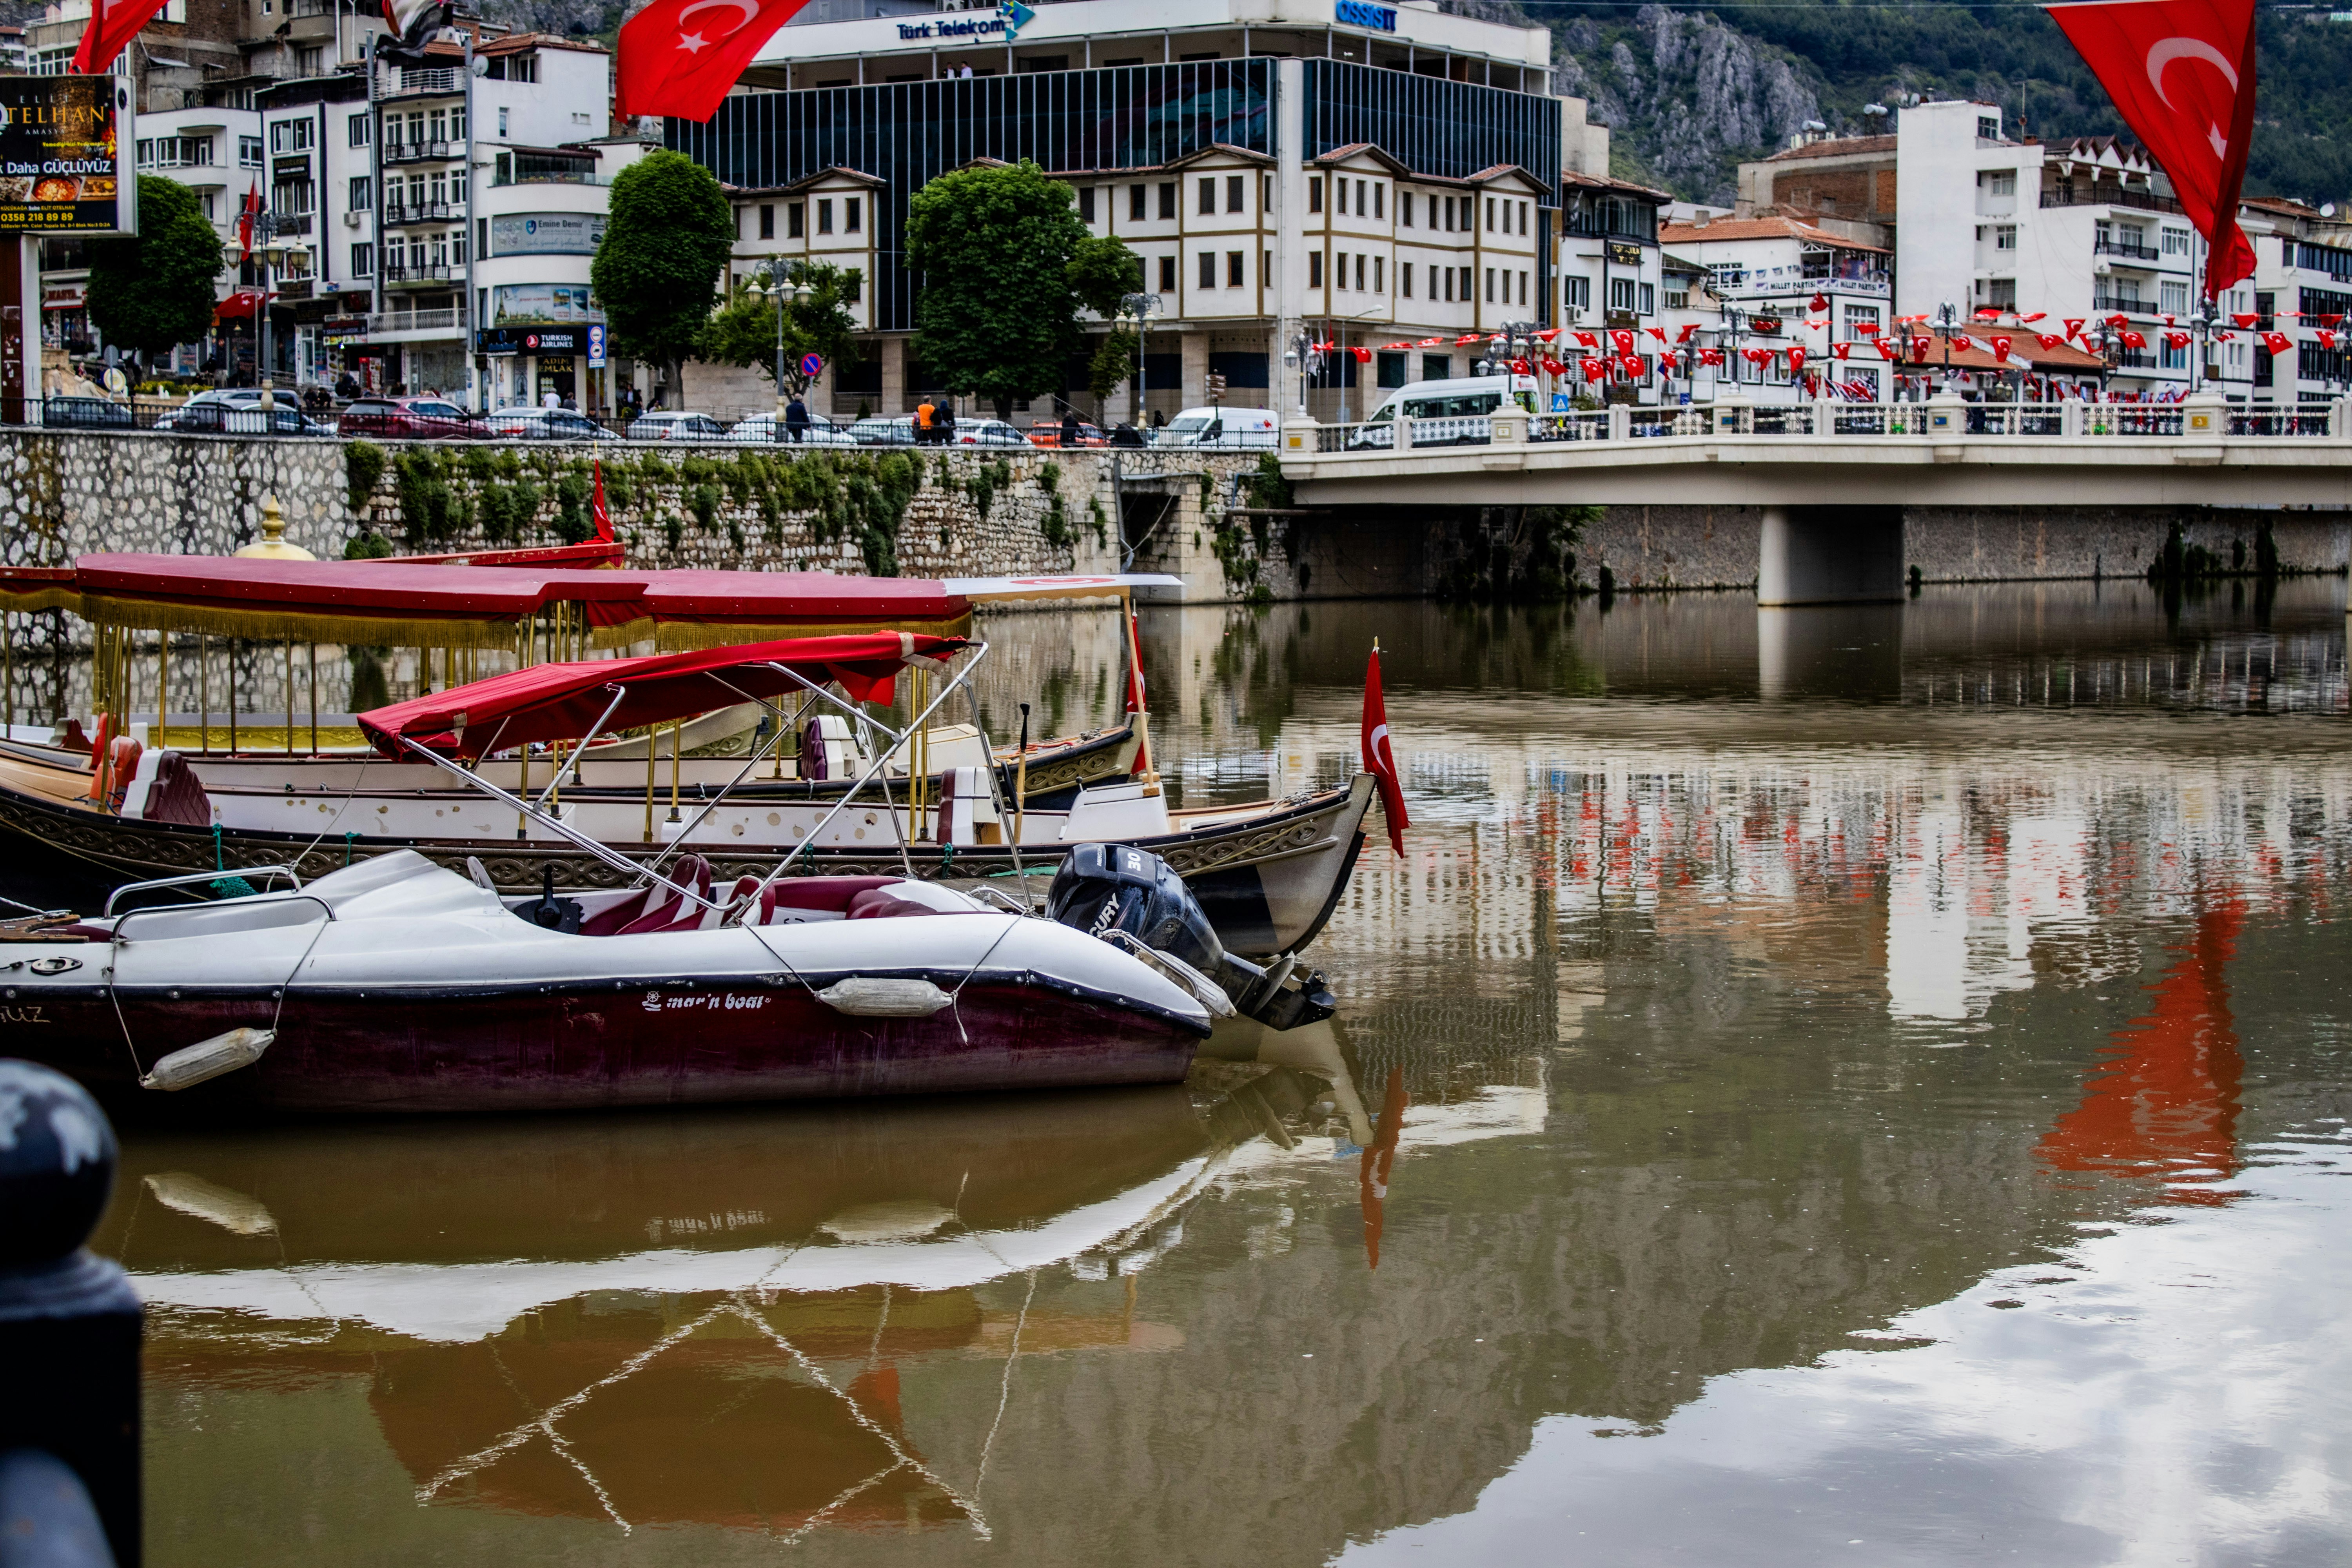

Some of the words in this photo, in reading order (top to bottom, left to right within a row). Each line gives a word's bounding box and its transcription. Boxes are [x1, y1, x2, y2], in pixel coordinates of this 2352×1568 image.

[897, 22, 930, 39] Türk
[935, 18, 1005, 36] Telekom
[7, 162, 39, 174] Daha
[43, 158, 111, 176] GÜÇLÜYÜZ
[1, 213, 25, 221] 0358
[46, 213, 58, 221] 89
[563, 220, 583, 228] Demir
[1770, 281, 1790, 290] MİLLET
[1793, 280, 1816, 289] PARTİSİ
[1127, 852, 1141, 872] 30
[1090, 893, 1120, 937] CURY
